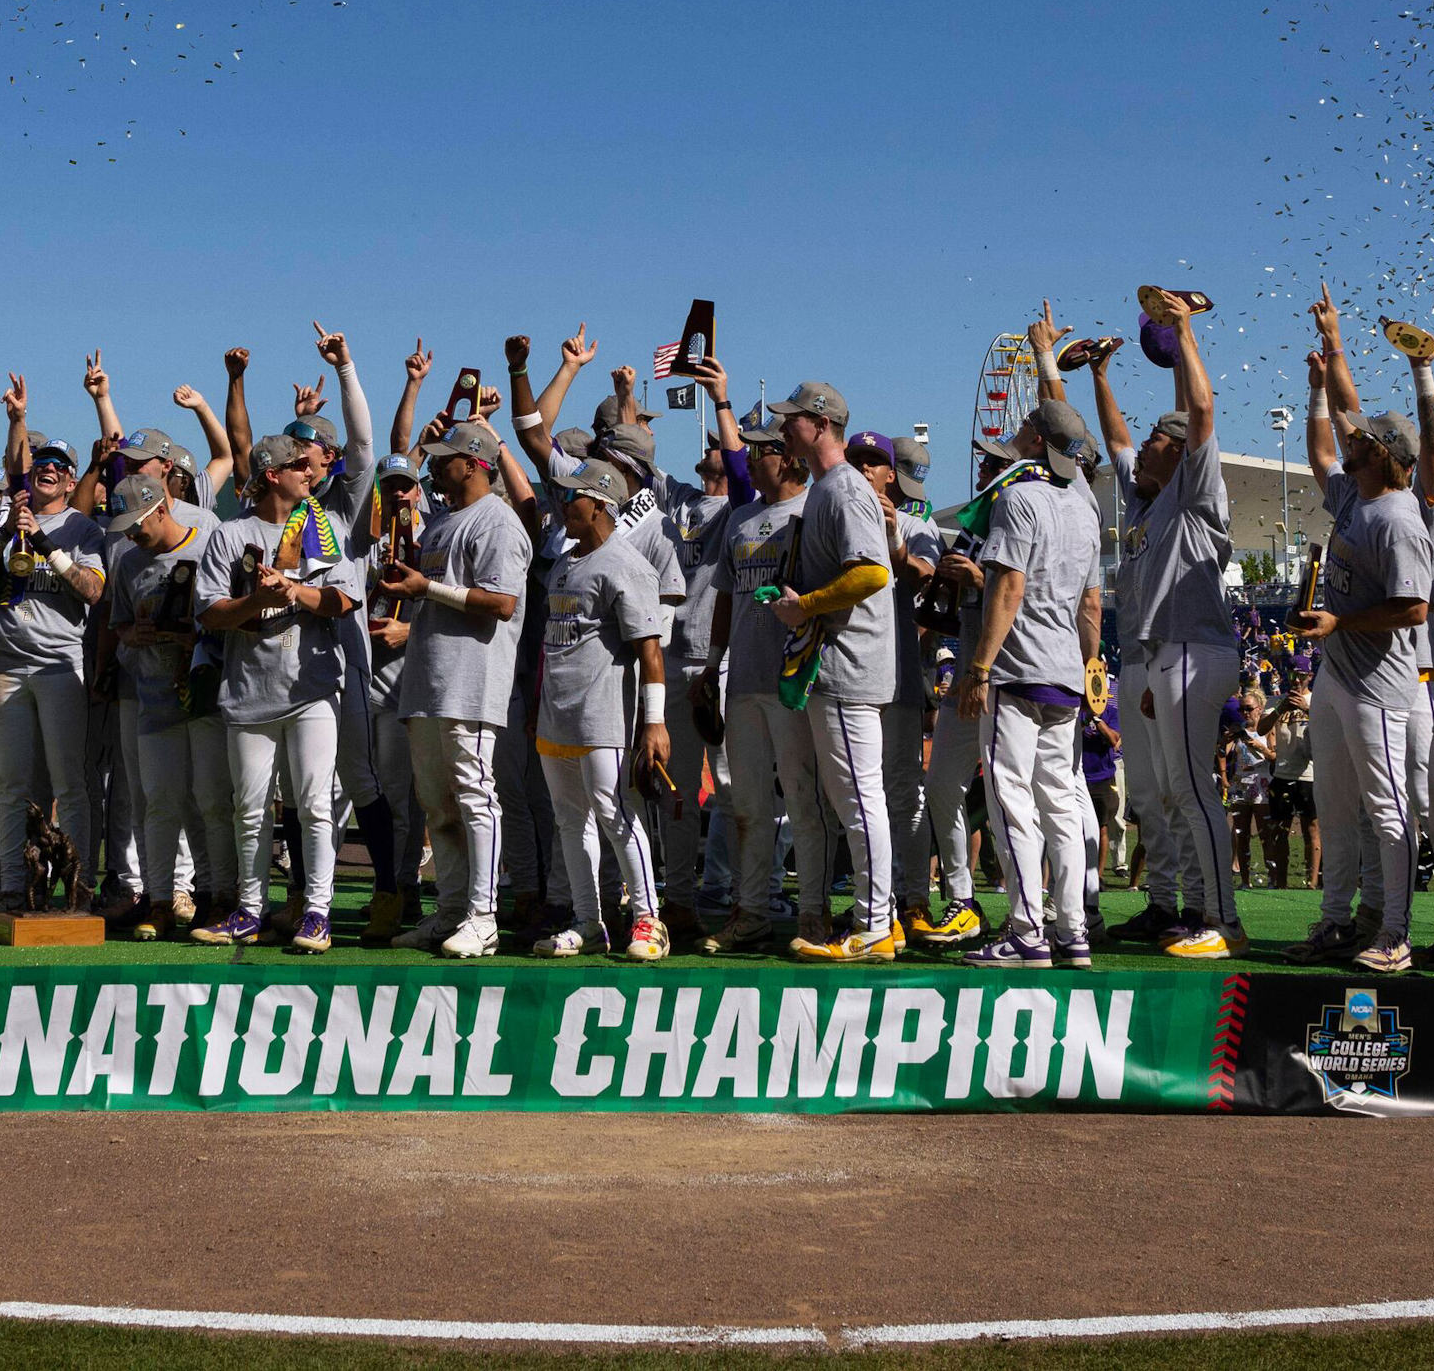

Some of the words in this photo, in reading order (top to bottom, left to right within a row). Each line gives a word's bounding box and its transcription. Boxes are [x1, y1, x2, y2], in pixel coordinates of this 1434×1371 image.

[1350, 1005, 1374, 1014] NCAA
[549, 984, 1134, 1099] CHAMPION
[1348, 1033, 1372, 1041] MEN'S
[1330, 1040, 1390, 1057] COLLEGE
[1310, 1054, 1359, 1072] WORLD
[1361, 1056, 1407, 1072] SERIES
[1344, 1073, 1374, 1081] OMAHA
